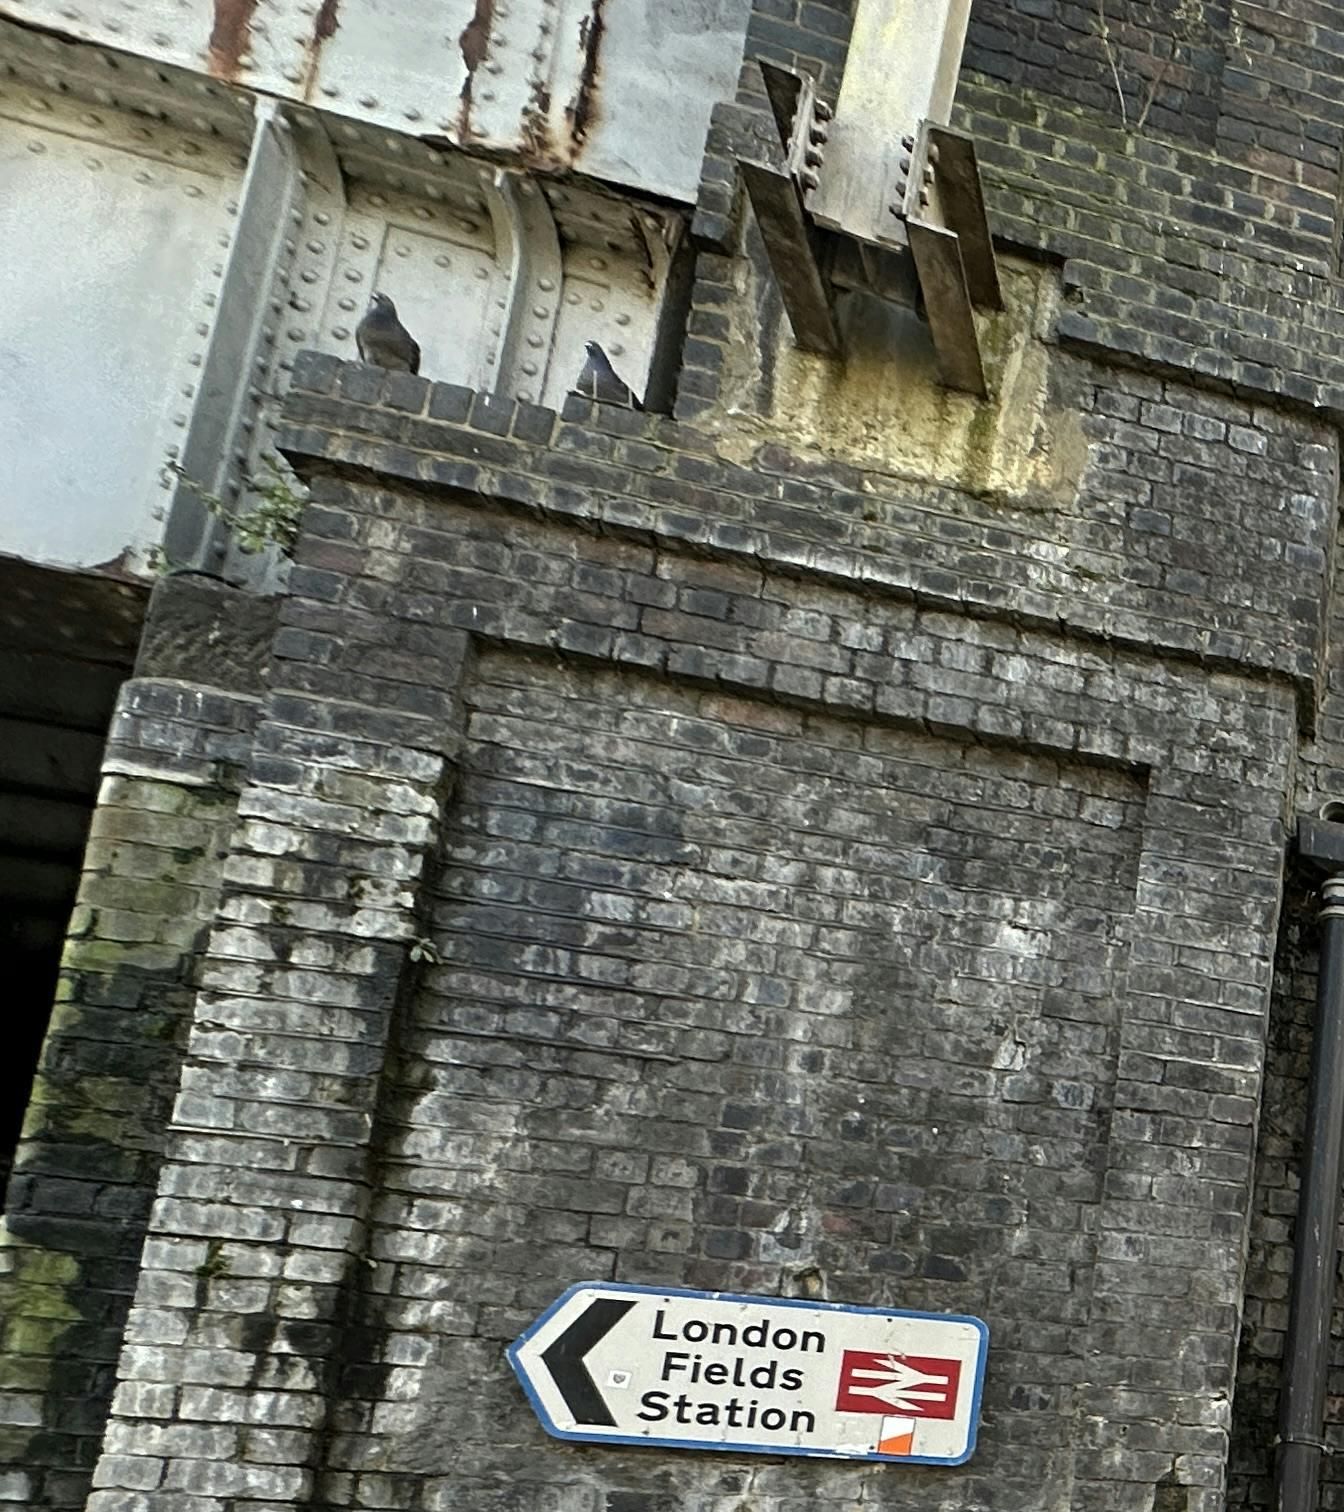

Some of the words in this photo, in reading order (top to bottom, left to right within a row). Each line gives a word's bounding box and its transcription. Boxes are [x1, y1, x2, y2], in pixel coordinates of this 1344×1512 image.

[652, 1309, 827, 1353] London
[660, 1351, 805, 1391] Fields
[636, 1390, 816, 1433] Station
